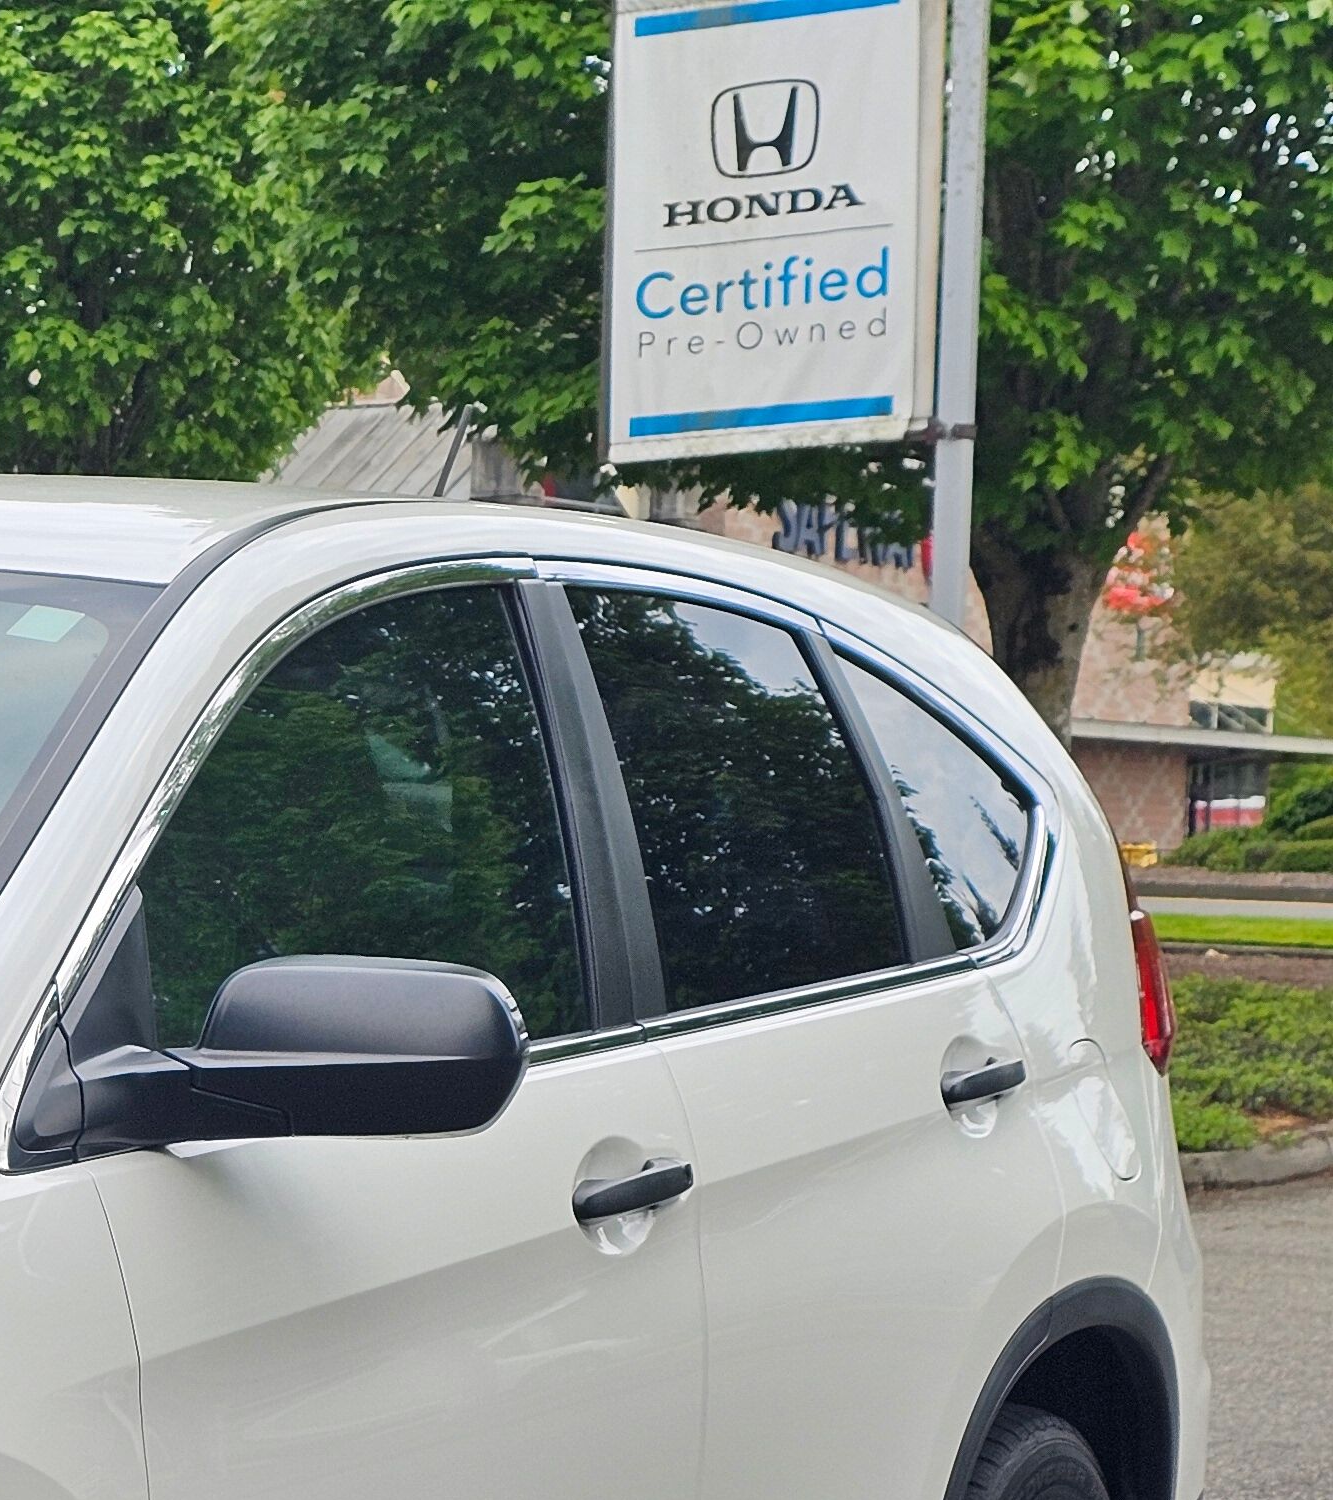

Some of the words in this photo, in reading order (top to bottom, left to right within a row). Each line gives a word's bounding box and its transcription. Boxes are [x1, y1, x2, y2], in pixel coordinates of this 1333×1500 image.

[663, 183, 866, 227] HONDA
[636, 245, 890, 319] Certified
[638, 307, 887, 358] Pre-Owned
